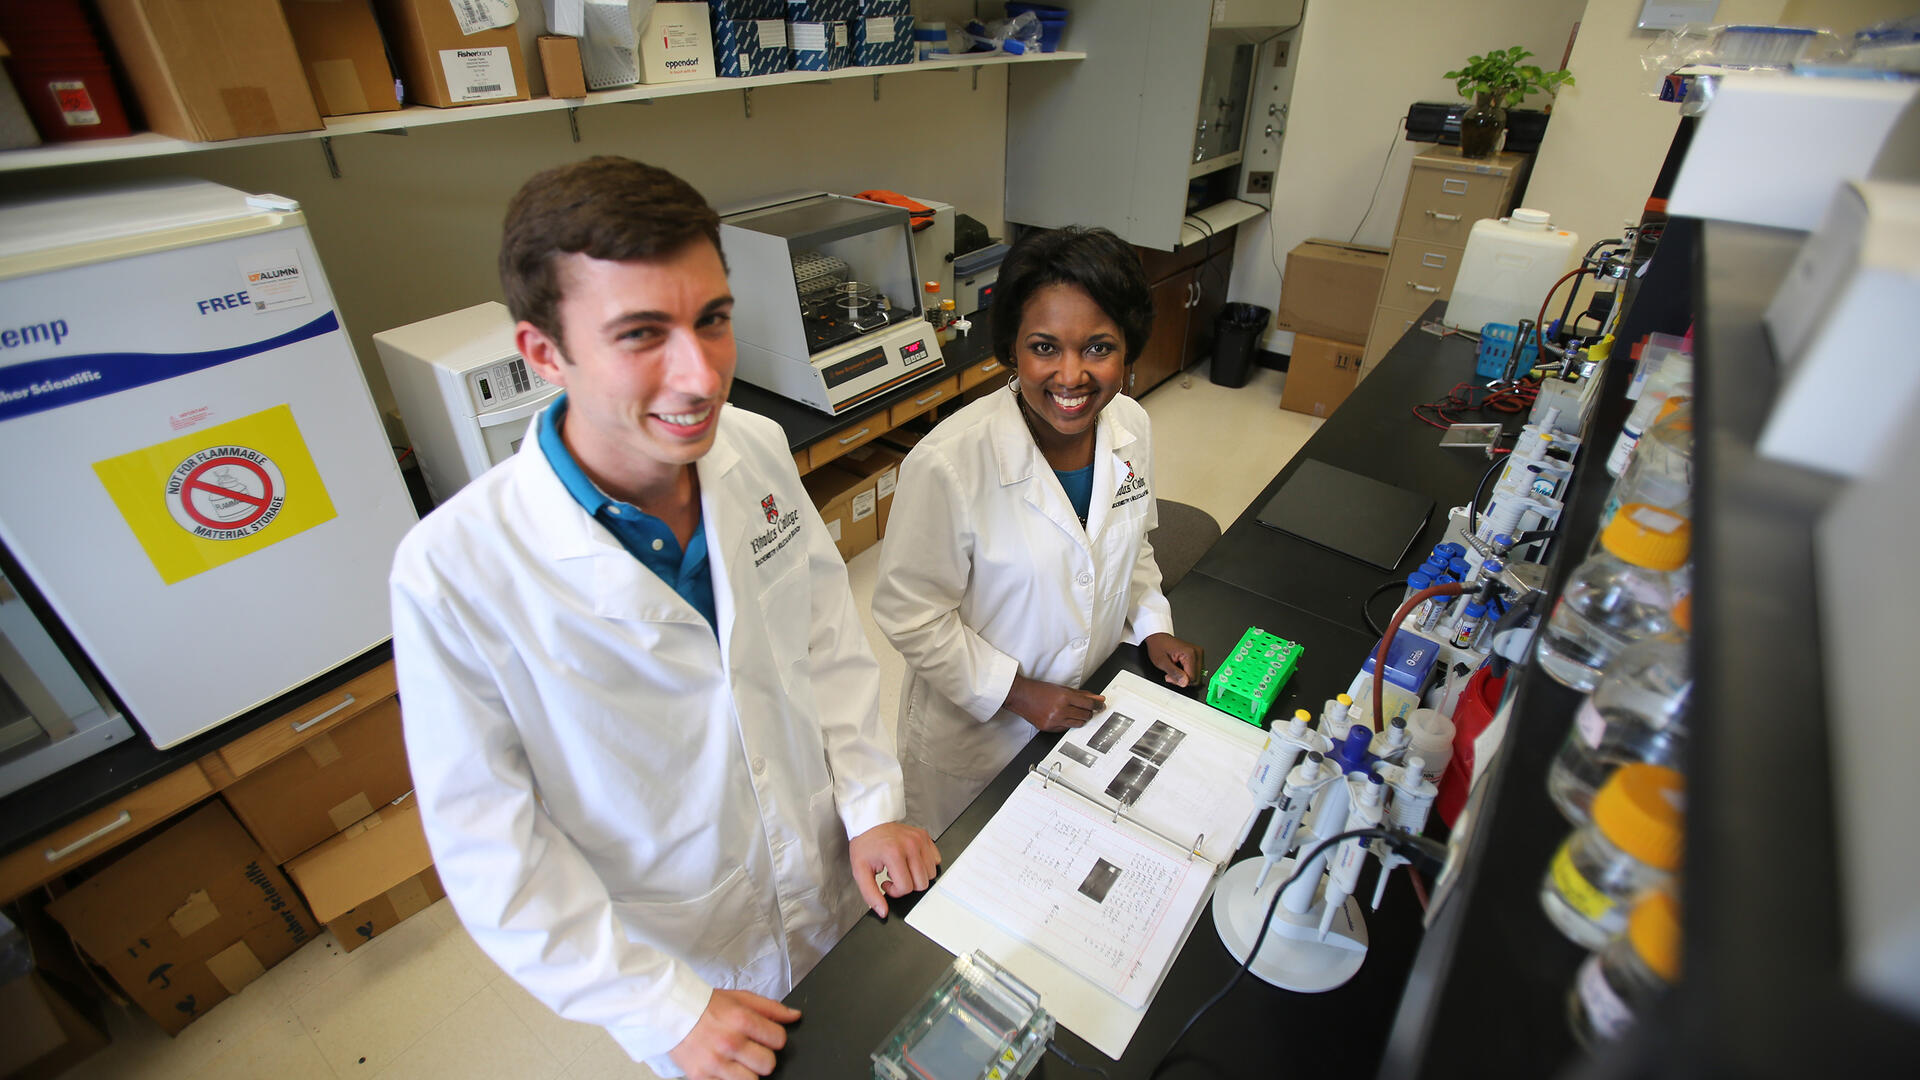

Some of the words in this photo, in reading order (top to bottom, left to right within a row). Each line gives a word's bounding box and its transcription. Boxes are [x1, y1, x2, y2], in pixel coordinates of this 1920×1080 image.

[457, 50, 492, 58] Fisherbrand
[665, 57, 699, 69] eppendorf
[0, 318, 69, 350] emp
[30, 371, 102, 396] Scientific
[167, 475, 183, 495] NOT
[177, 458, 198, 476] FOR
[197, 447, 268, 466] FLAMMABLE
[193, 525, 250, 539] MATERIAL
[251, 496, 284, 532] STORAGE
